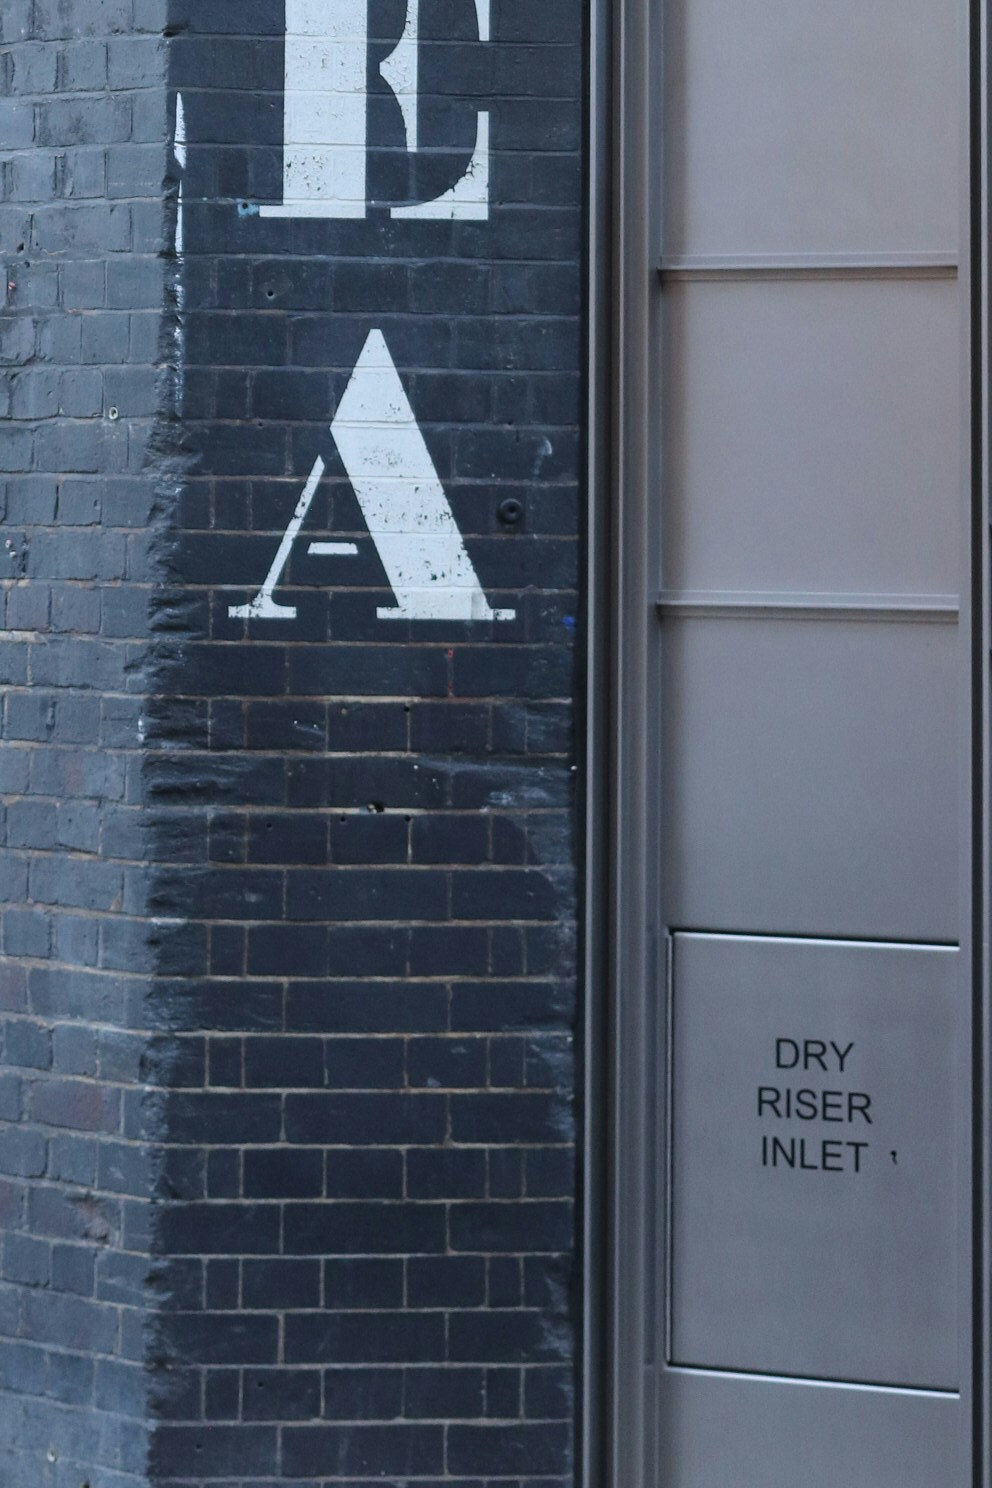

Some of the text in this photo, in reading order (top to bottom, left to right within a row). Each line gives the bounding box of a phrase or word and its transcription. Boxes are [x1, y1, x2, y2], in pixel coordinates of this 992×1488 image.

[775, 1037, 854, 1073] DRY
[757, 1085, 873, 1125] RISER
[761, 1135, 870, 1173] INLET
